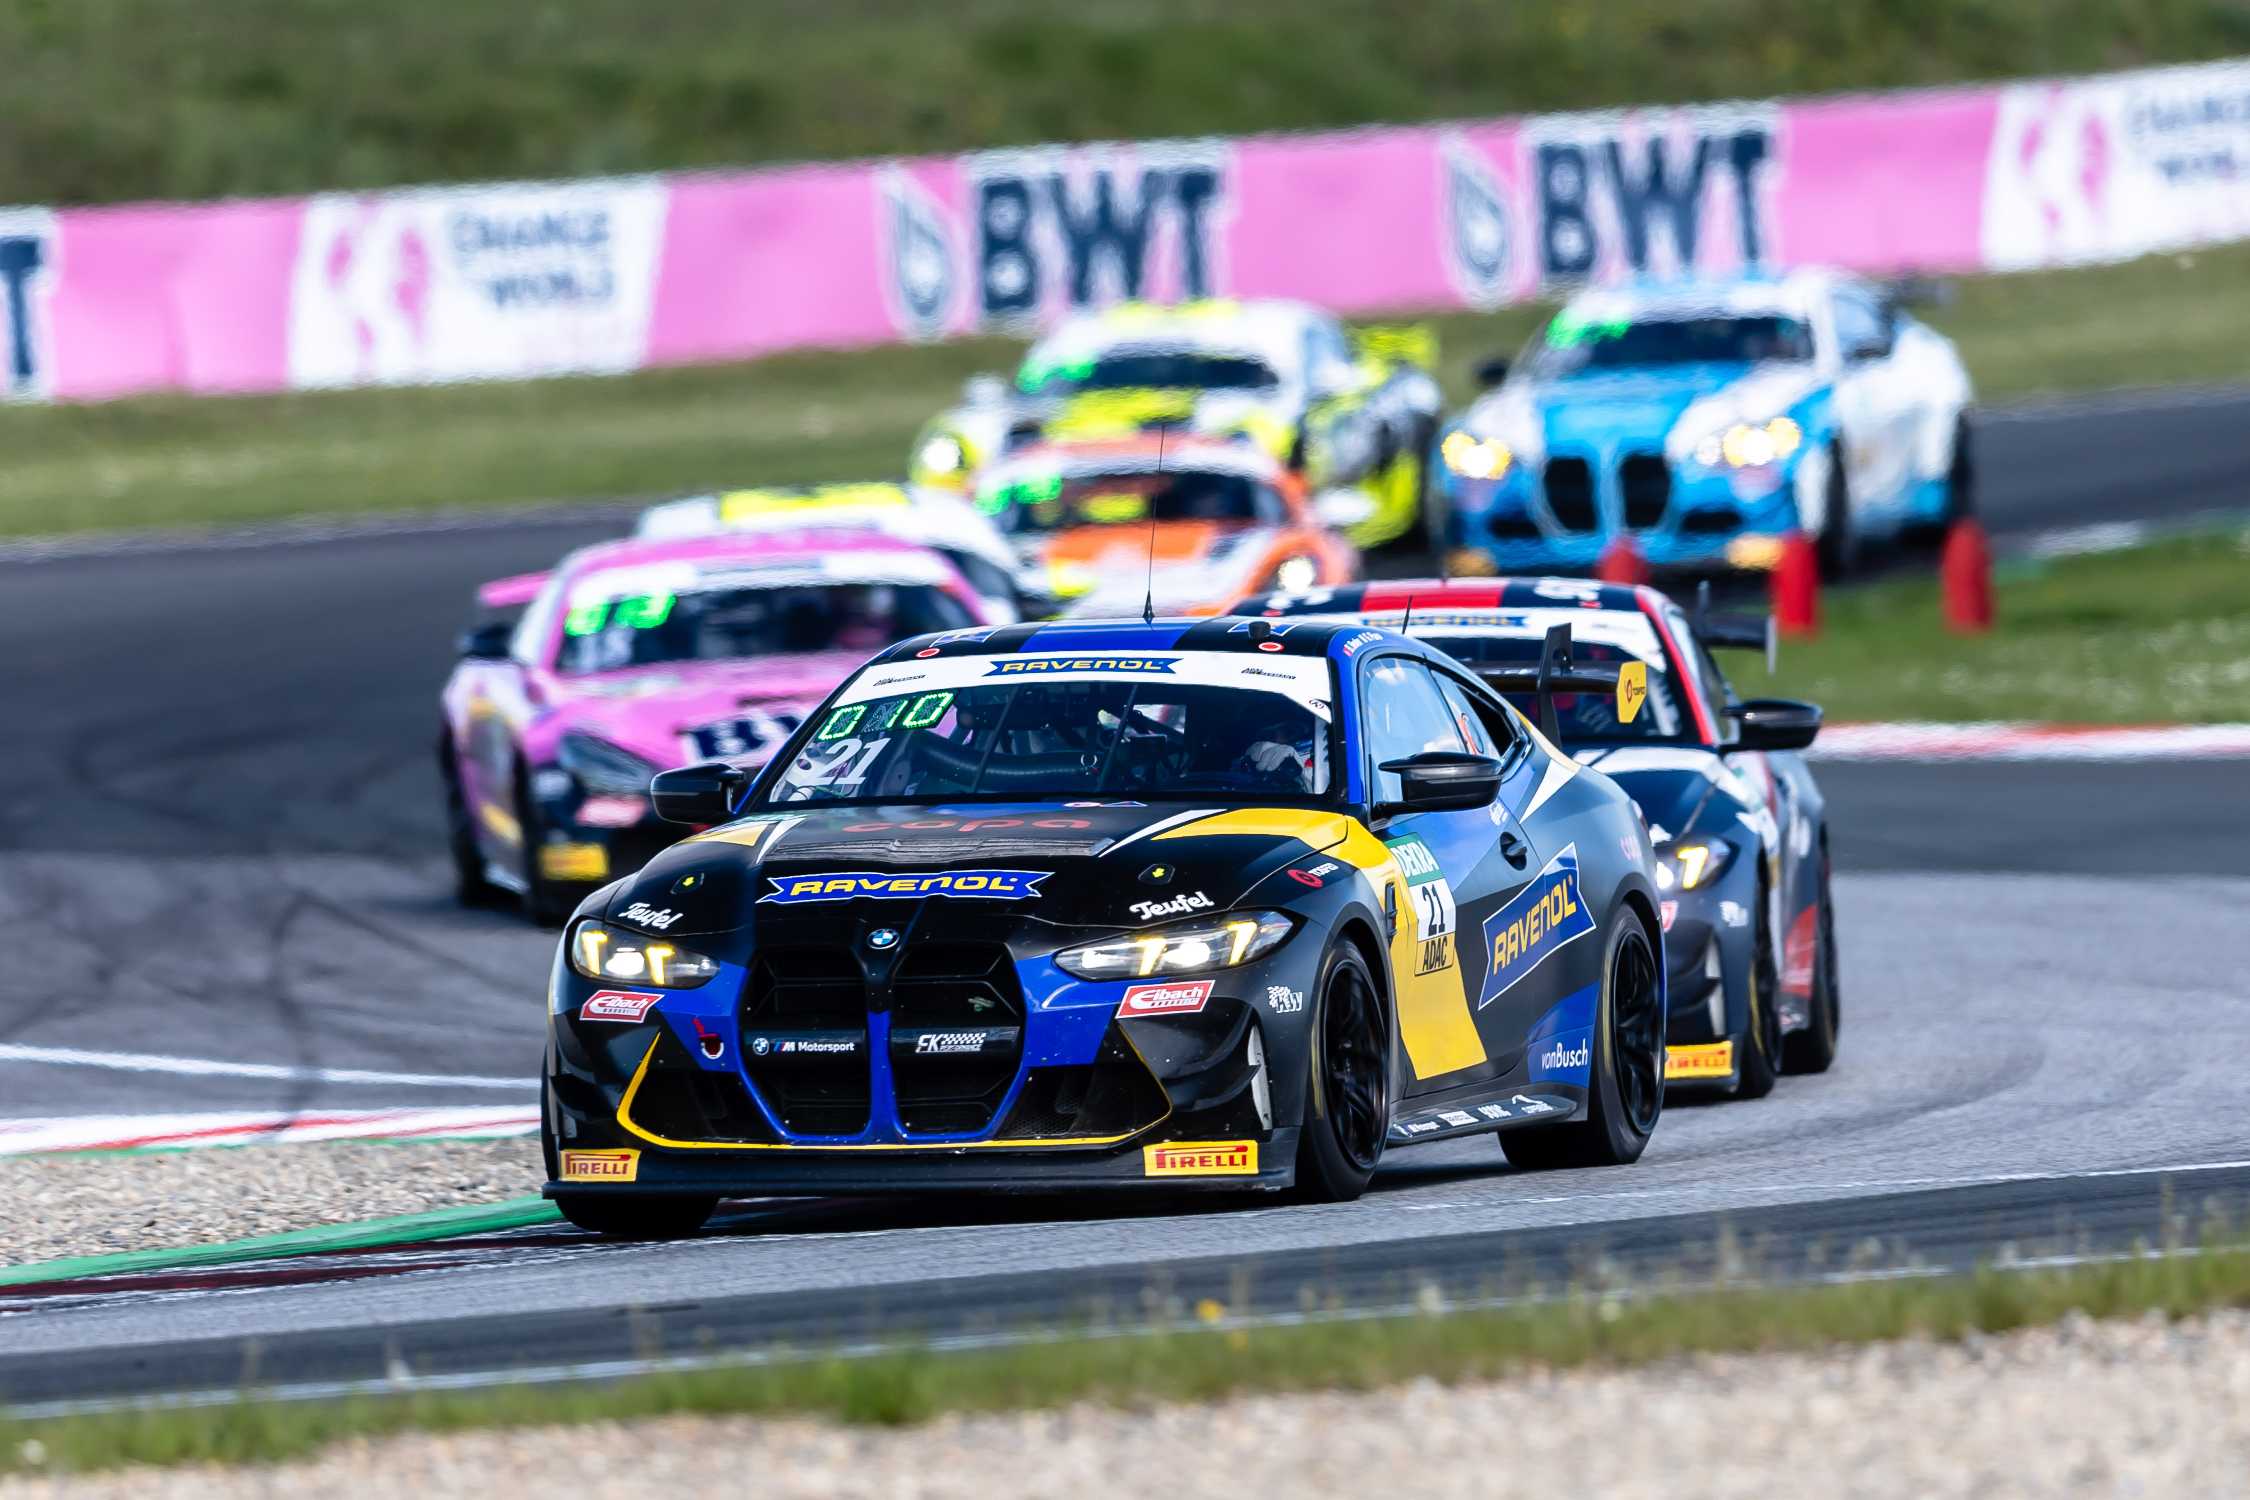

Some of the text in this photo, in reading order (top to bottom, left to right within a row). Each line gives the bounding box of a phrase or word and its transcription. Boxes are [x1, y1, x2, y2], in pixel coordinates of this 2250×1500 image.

[1536, 127, 1768, 277] BWT
[981, 163, 1219, 314] BWT
[1002, 660, 1162, 673] RAVENOL
[815, 737, 892, 785] 21
[842, 818, 1091, 832] copa
[1391, 840, 1440, 879] DEKRA
[790, 875, 1017, 897] RAVENOL
[618, 902, 684, 930] Teufel
[1129, 891, 1215, 921] Teufel
[1422, 883, 1446, 937] 21
[1493, 875, 1578, 977] RAVENOL
[1422, 937, 1449, 972] ADAC
[588, 994, 650, 1015] Eibach
[1129, 986, 1204, 1010] Eibach
[798, 1040, 855, 1054] Motorsport
[915, 1034, 943, 1053] FK
[1541, 1037, 1588, 1071] vonBusch
[565, 1152, 632, 1175] PIRELLI
[1155, 1145, 1248, 1169] PIRELLI
